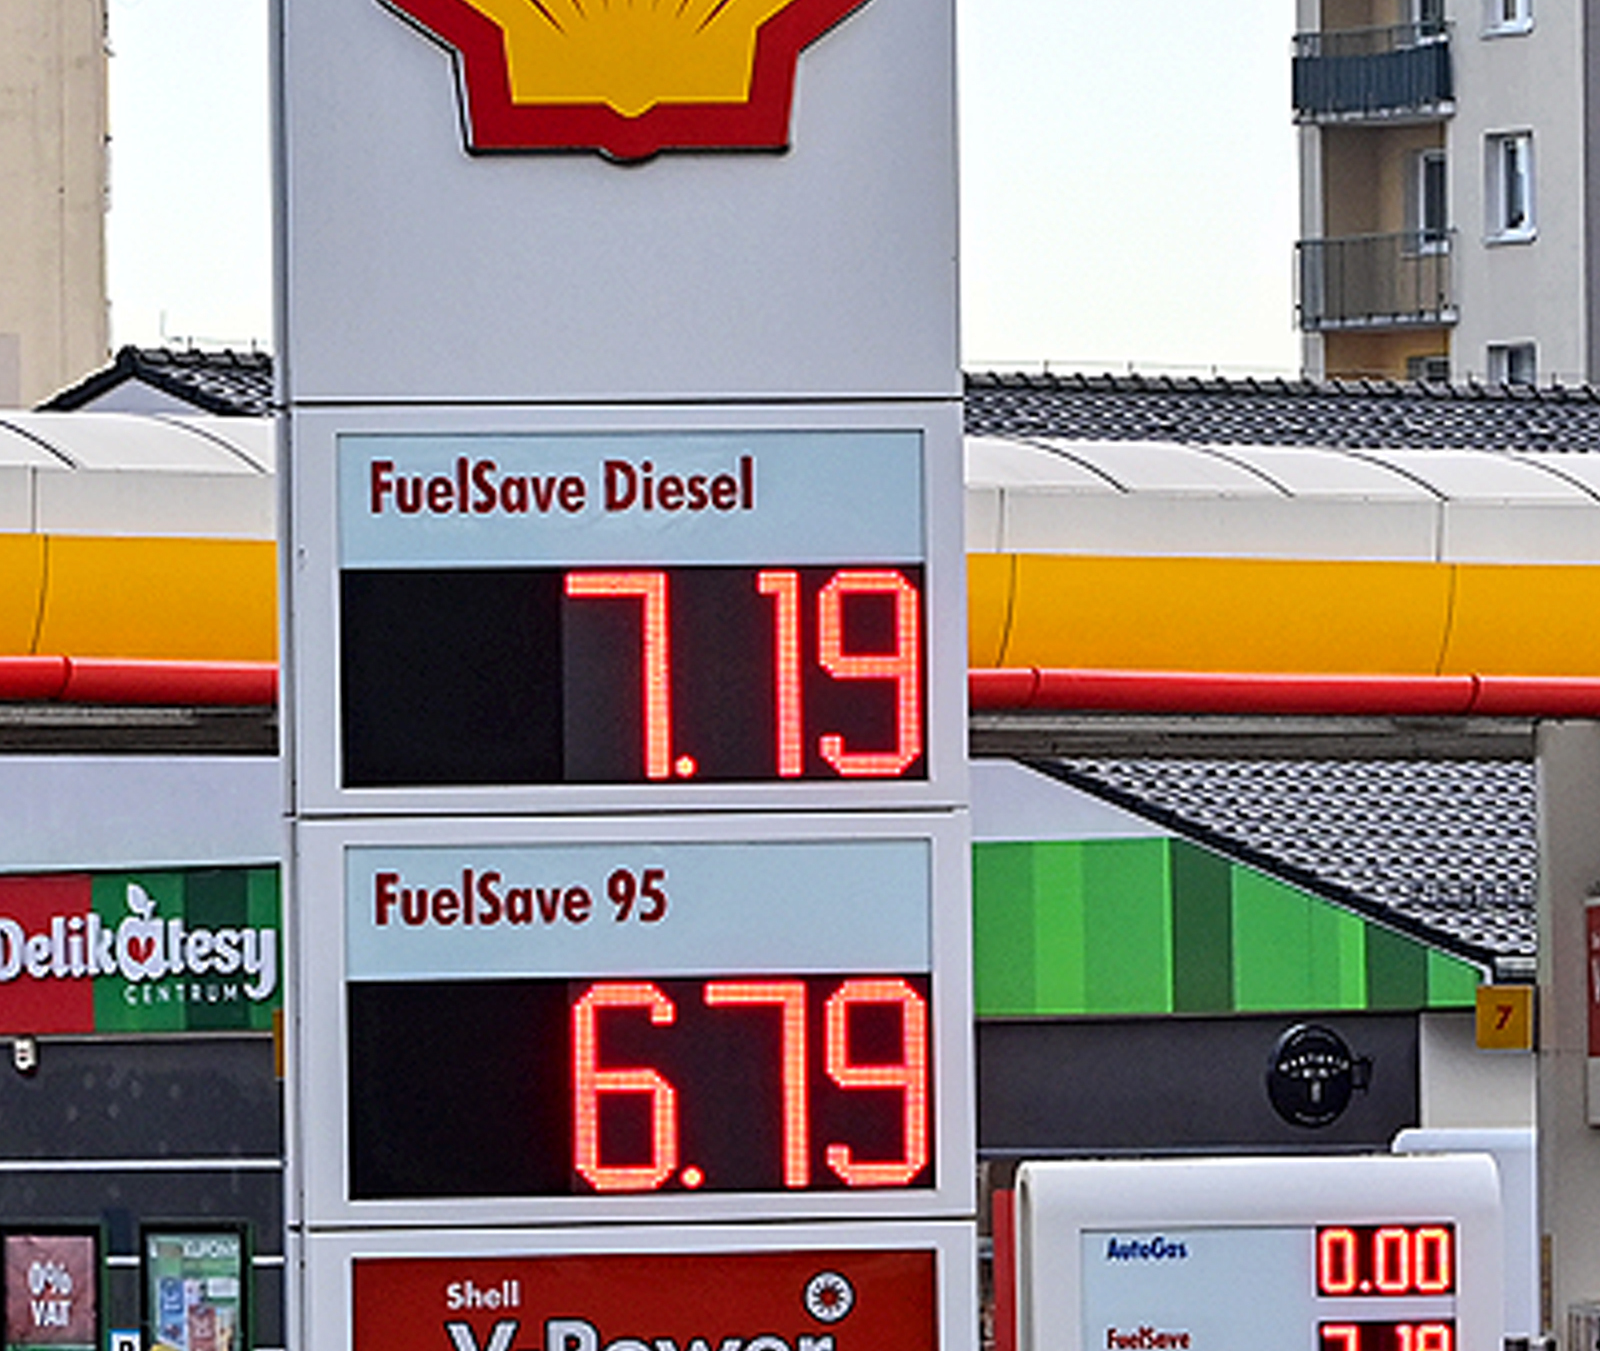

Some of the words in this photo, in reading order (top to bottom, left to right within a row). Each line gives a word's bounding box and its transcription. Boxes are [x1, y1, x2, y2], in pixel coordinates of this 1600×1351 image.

[370, 458, 586, 514] FuelSave
[604, 457, 754, 511] Diesel
[565, 570, 921, 779] 7.19
[374, 869, 591, 926] FuelSave
[606, 869, 668, 922] 95
[123, 982, 239, 1004] CENTRUM
[1496, 1005, 1514, 1031] 7
[573, 978, 928, 1191] 6.79
[1107, 1237, 1189, 1261] AutoGas
[1320, 1228, 1450, 1293] 0.00
[28, 1260, 72, 1296] 0%
[446, 1280, 520, 1309] Shell
[31, 1300, 71, 1327] VAT
[1107, 1328, 1190, 1351] FuelSave
